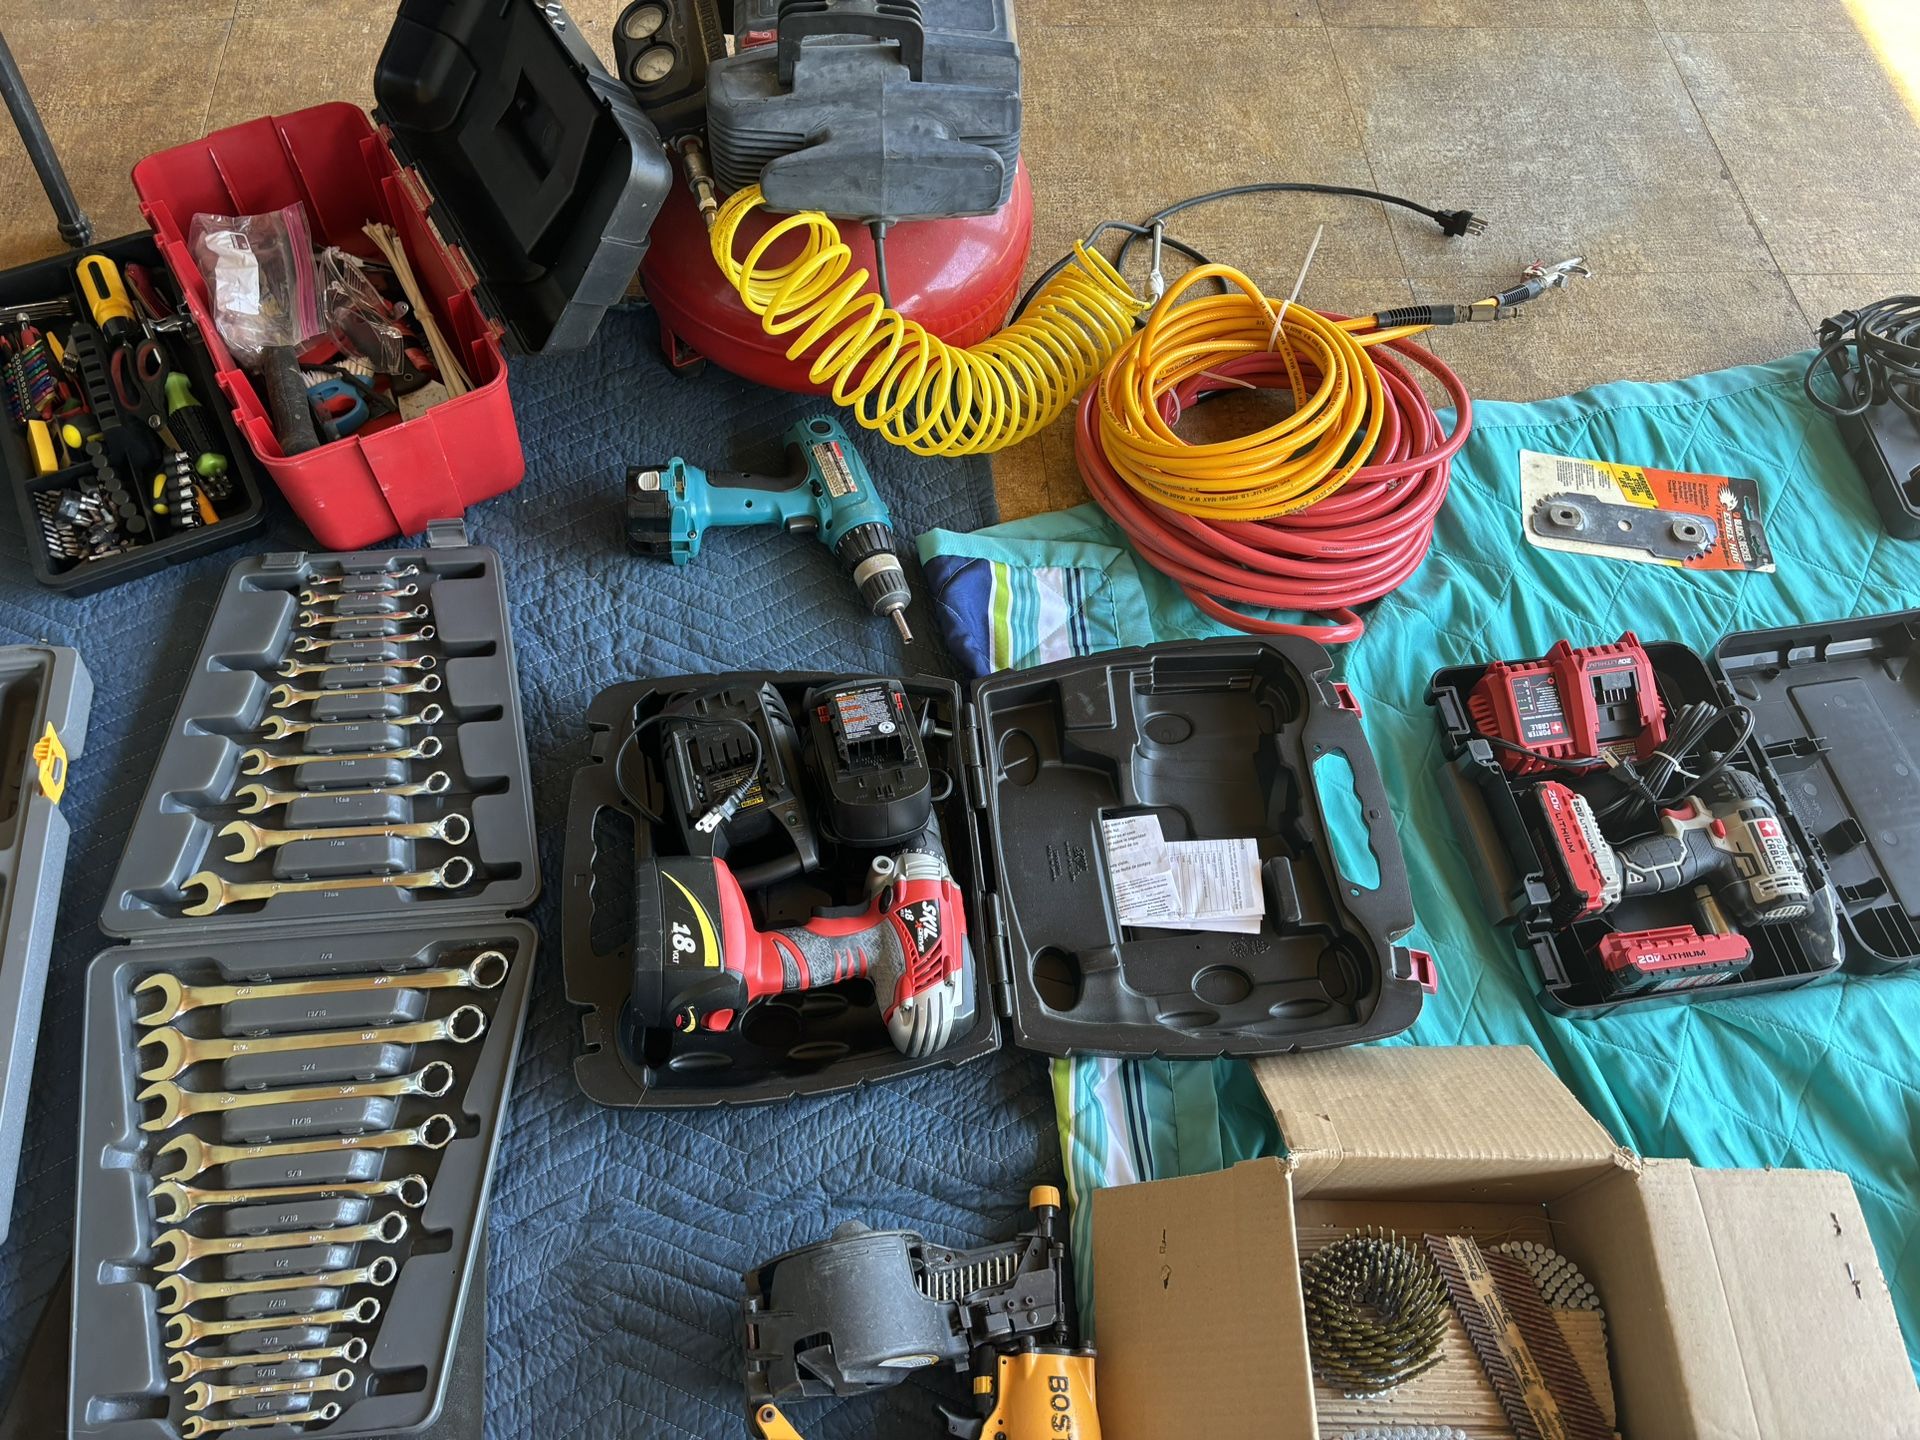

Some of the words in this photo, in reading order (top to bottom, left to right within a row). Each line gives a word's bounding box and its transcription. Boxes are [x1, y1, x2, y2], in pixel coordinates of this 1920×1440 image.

[1723, 511, 1735, 541] EDGE
[1728, 542, 1741, 563] HOG
[1556, 812, 1577, 855] LITHIUM
[1579, 817, 1597, 852] LITHIUM
[1765, 835, 1782, 866] CABLE
[1774, 837, 1794, 874] PORTER
[903, 907, 914, 922] 18
[921, 901, 938, 939] SKIL
[671, 921, 697, 955] 18
[672, 950, 680, 965] VOLT
[1637, 953, 1661, 964] 20V
[1661, 949, 1707, 961] LITHIUM
[291, 1117, 312, 1126] 11/16
[257, 1402, 271, 1410] 1/4
